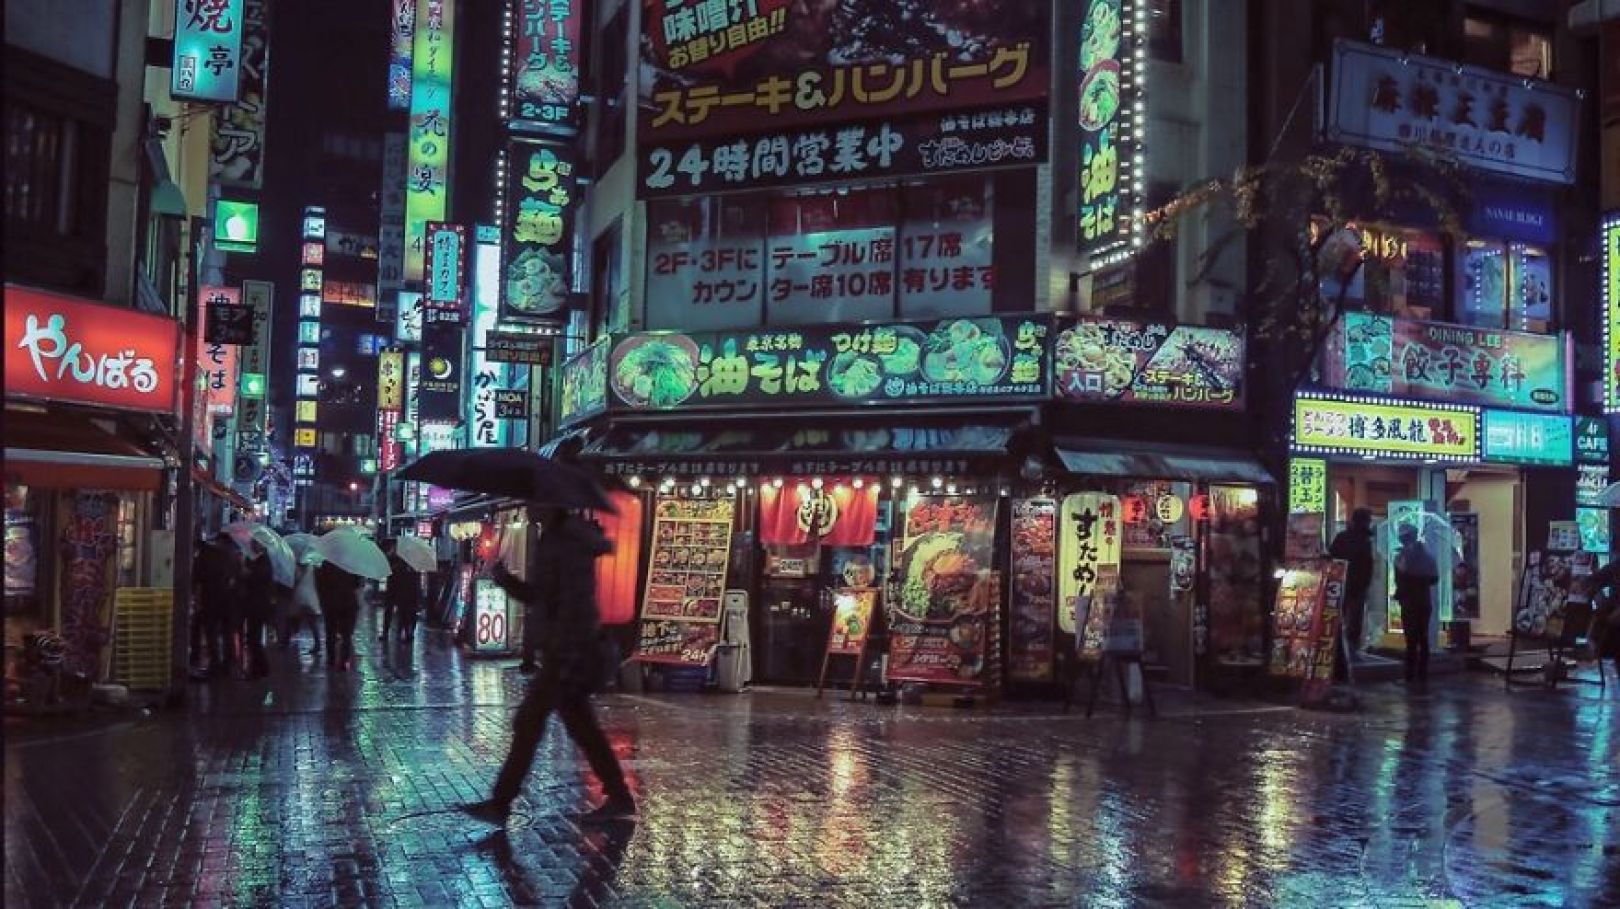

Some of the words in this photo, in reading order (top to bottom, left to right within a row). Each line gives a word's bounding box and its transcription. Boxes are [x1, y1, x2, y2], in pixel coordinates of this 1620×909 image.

[651, 42, 1031, 127] ステーキ&ハンバーグ
[646, 122, 904, 189] 24時間営業中
[1430, 326, 1474, 345] DINING
[19, 313, 159, 393] やんばる
[700, 338, 828, 398] 油そば
[1068, 373, 1102, 392] 入口
[1348, 413, 1428, 443] 博多風龍
[1577, 436, 1608, 451] CAFE
[478, 612, 504, 645] 80
